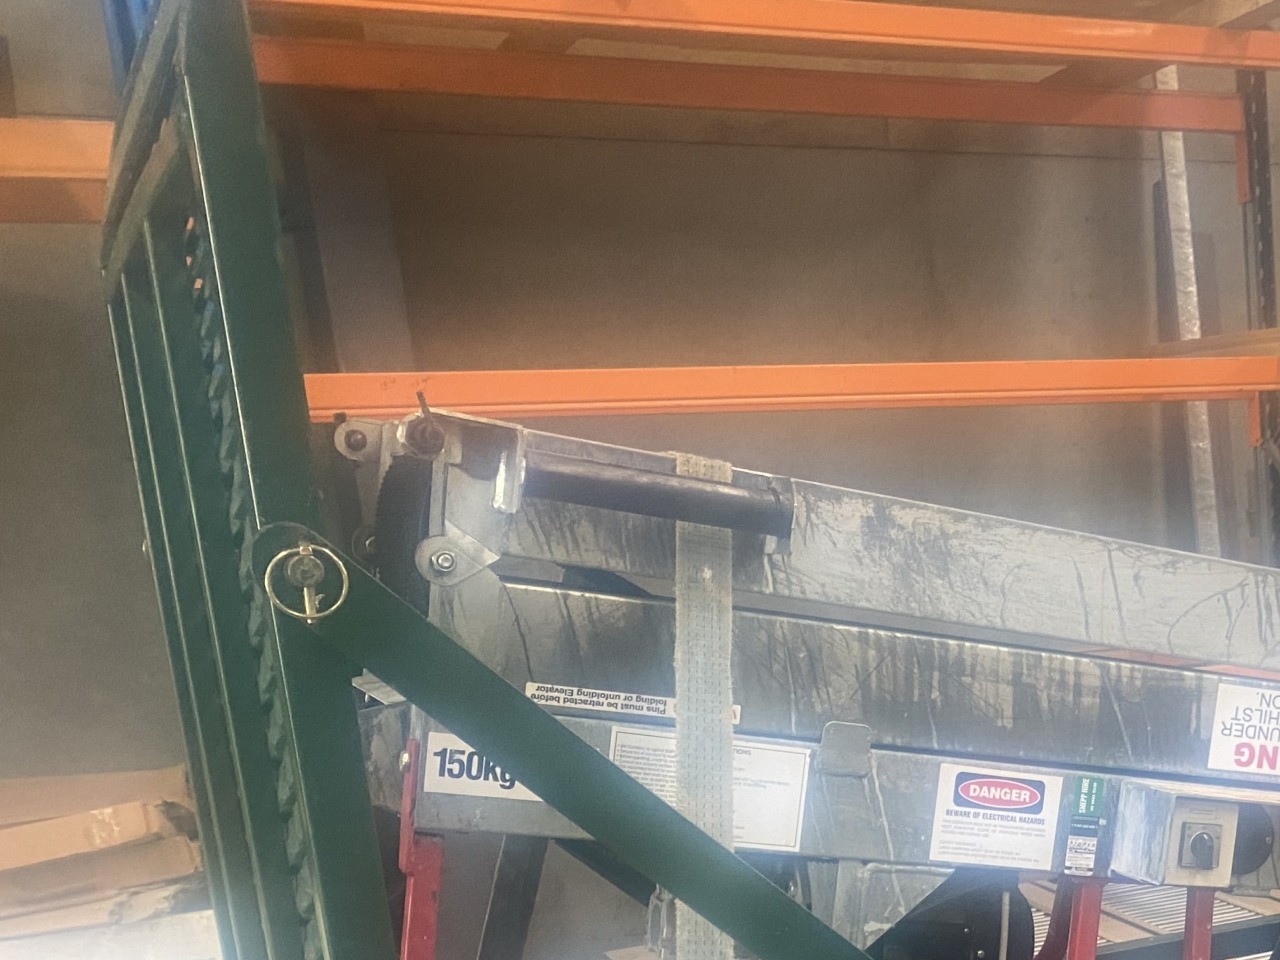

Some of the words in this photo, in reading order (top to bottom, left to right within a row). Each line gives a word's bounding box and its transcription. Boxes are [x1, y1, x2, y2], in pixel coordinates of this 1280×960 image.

[535, 685, 574, 697] Elevator
[576, 689, 621, 702] unfolding
[530, 693, 560, 704] before
[563, 697, 604, 708] retracted
[635, 696, 667, 707] folding
[606, 701, 619, 711] be
[620, 703, 644, 712] must
[646, 706, 666, 715] Pins
[1220, 721, 1280, 742] UNDER
[968, 784, 1031, 803] DANGER
[945, 809, 971, 818] BEWARE
[972, 811, 981, 819] OF
[982, 812, 1017, 823] ELECTRICAL
[1019, 816, 1046, 826] HAZARDS
